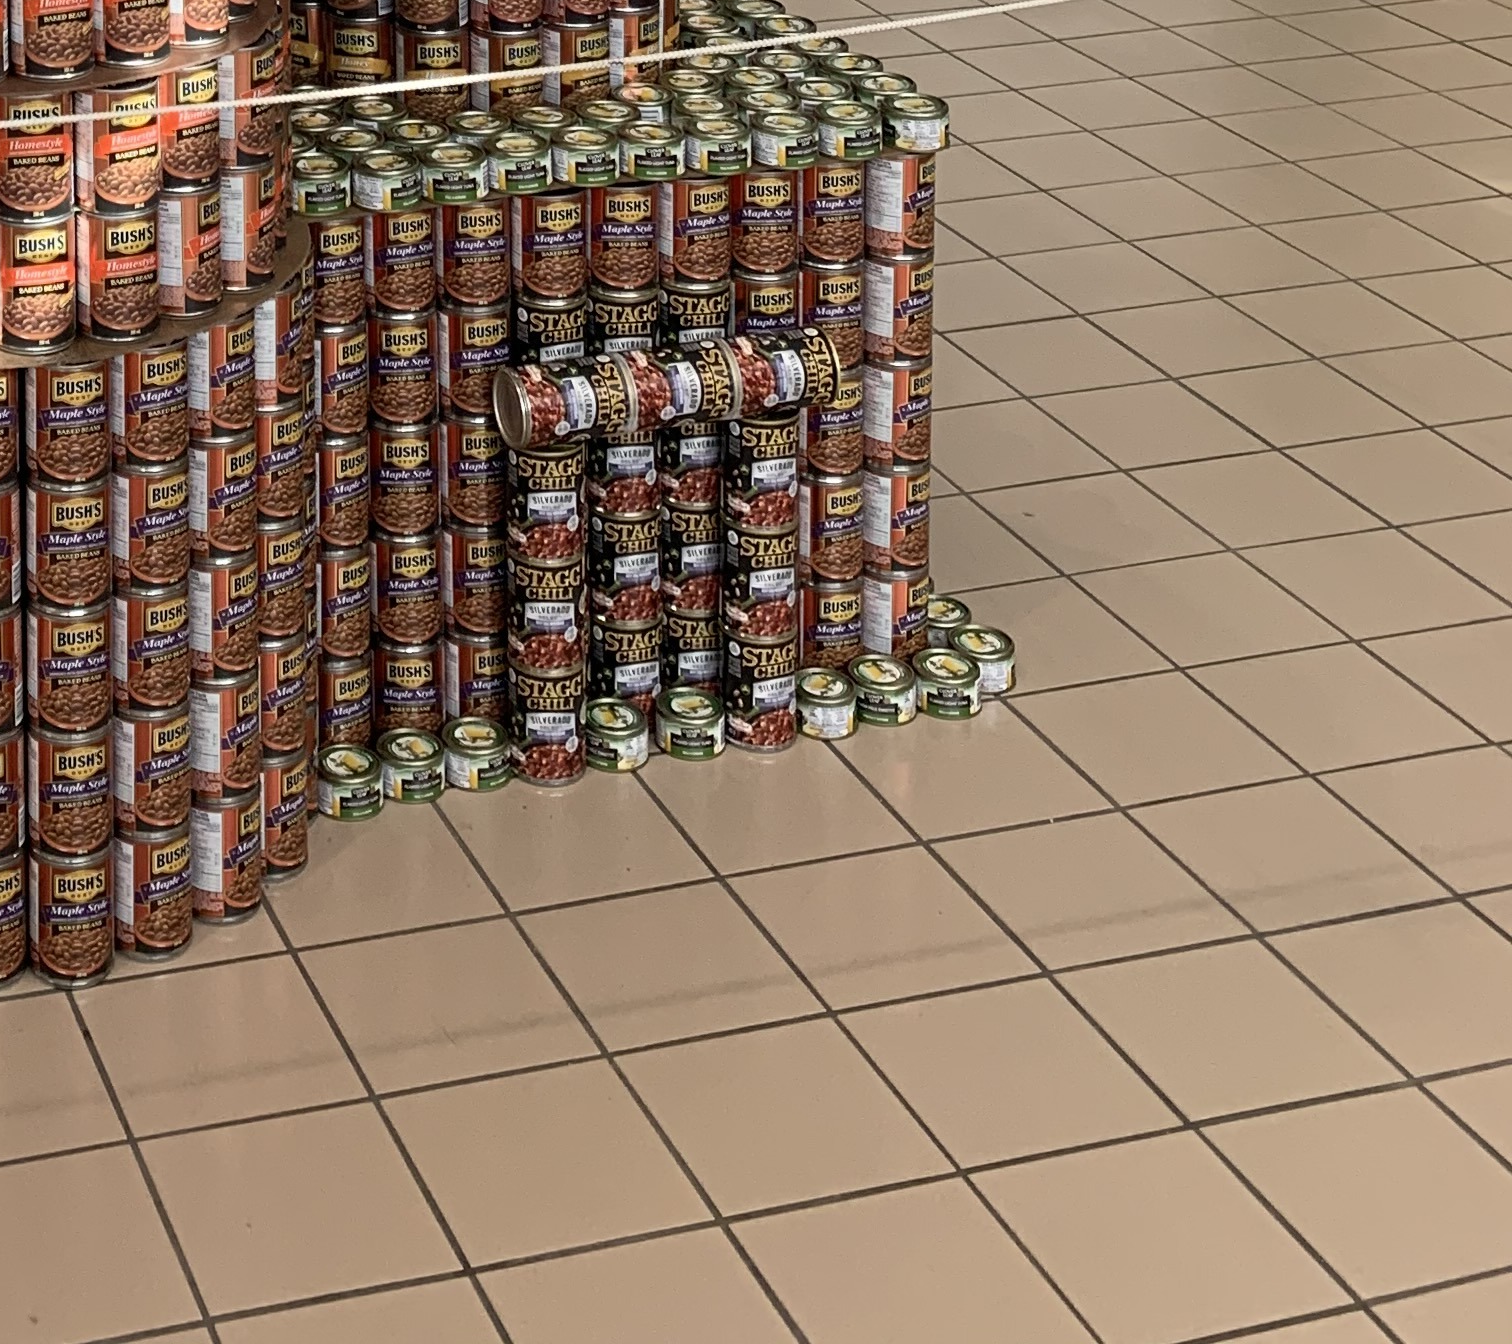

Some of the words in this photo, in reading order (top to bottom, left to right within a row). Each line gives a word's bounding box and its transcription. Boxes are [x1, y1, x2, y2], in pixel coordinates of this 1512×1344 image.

[608, 200, 649, 213] BUSH'S
[17, 235, 64, 254] BUSH'S
[821, 280, 860, 295] BUSH'S
[384, 333, 427, 349] BUSH'S
[377, 358, 406, 369] Maple
[408, 357, 431, 368] Style
[518, 457, 583, 476] STAGG
[528, 474, 576, 489] CHILI
[529, 493, 574, 504] SILVERADO
[389, 664, 431, 680] BUSH'S
[516, 675, 583, 699] STAGG
[527, 697, 575, 710] CHILI
[56, 874, 104, 892] BUSH'S
